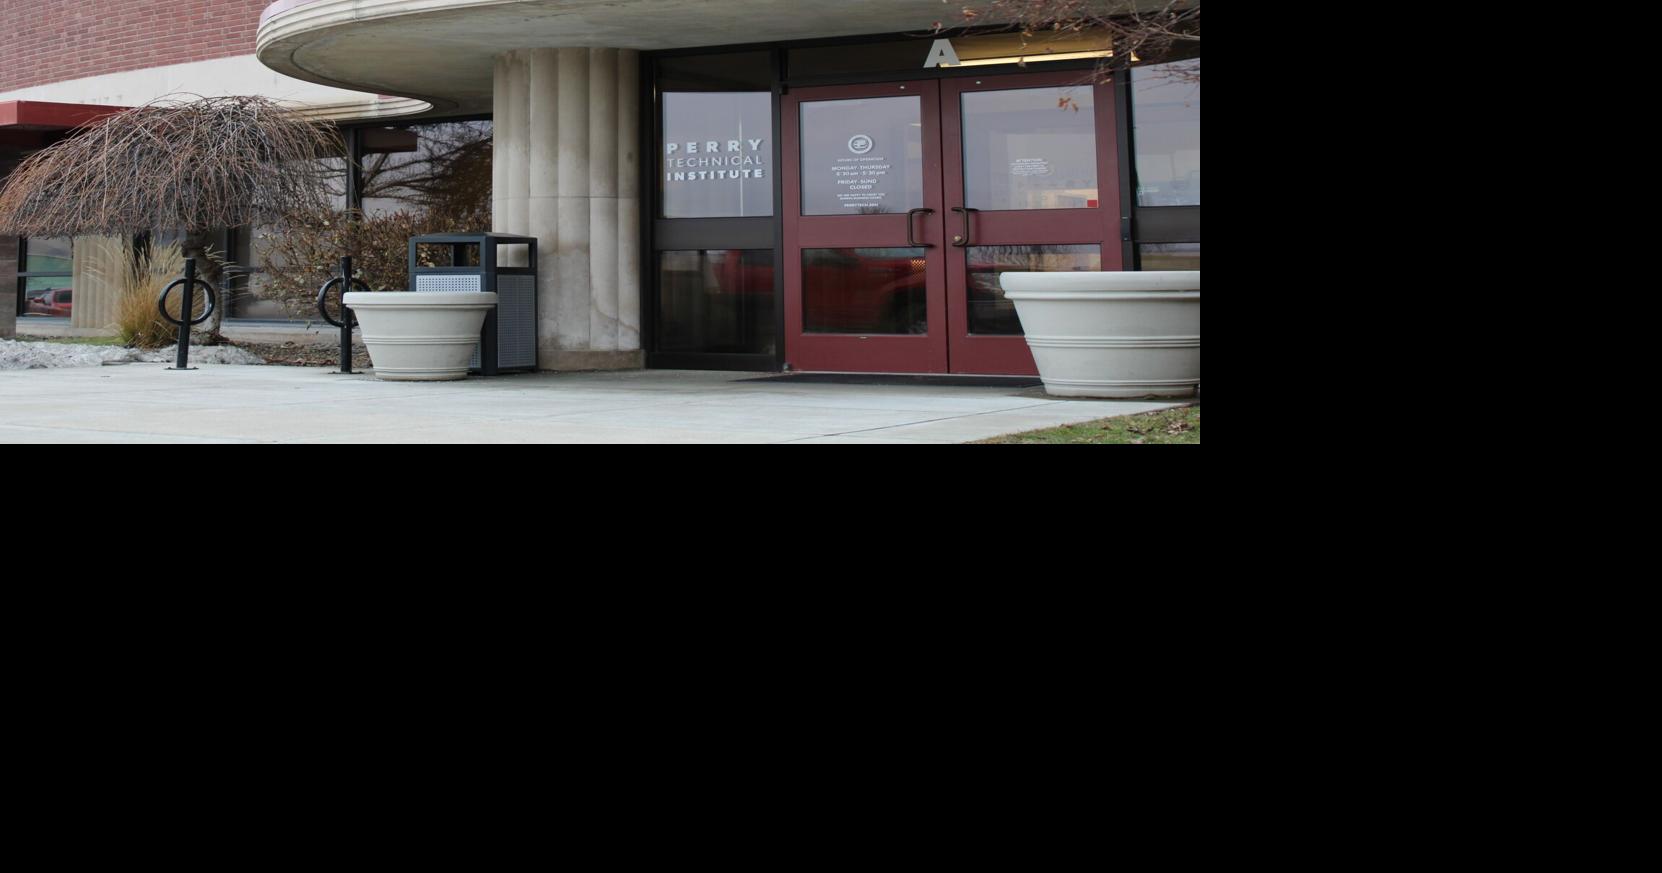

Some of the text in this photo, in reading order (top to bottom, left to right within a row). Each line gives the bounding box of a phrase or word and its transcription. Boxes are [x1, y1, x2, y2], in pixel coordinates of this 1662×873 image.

[923, 38, 961, 68] A
[666, 139, 762, 154] PERRY
[666, 155, 762, 168] TECHNICAL
[666, 168, 763, 181] INSTITUTE
